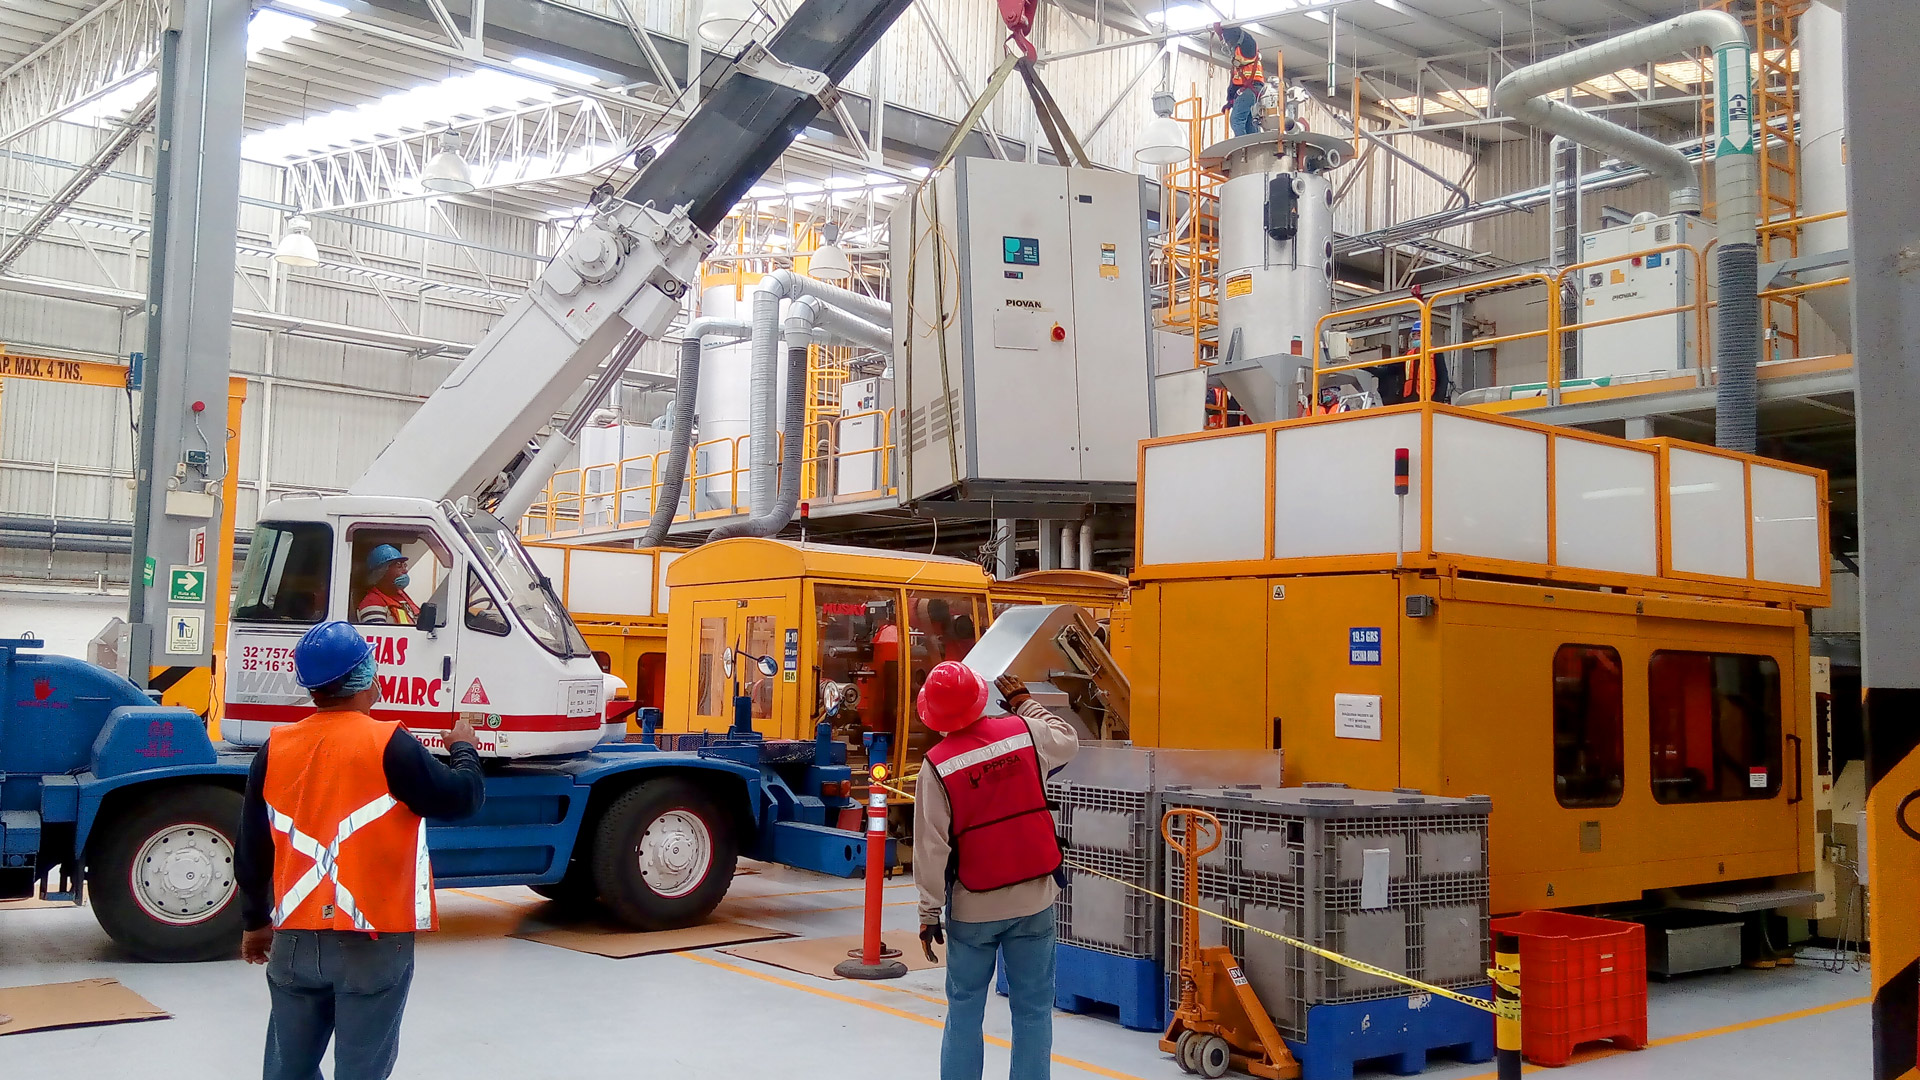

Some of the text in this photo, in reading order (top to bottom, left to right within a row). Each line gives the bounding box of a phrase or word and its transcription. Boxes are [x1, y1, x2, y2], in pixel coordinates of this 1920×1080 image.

[1005, 299, 1042, 308] PIOVAN
[0, 356, 83, 381] P. MAX. 4 TNS.
[823, 603, 867, 616] HUSKY
[1352, 631, 1365, 643] 19.5
[1230, 968, 1242, 978] BV
